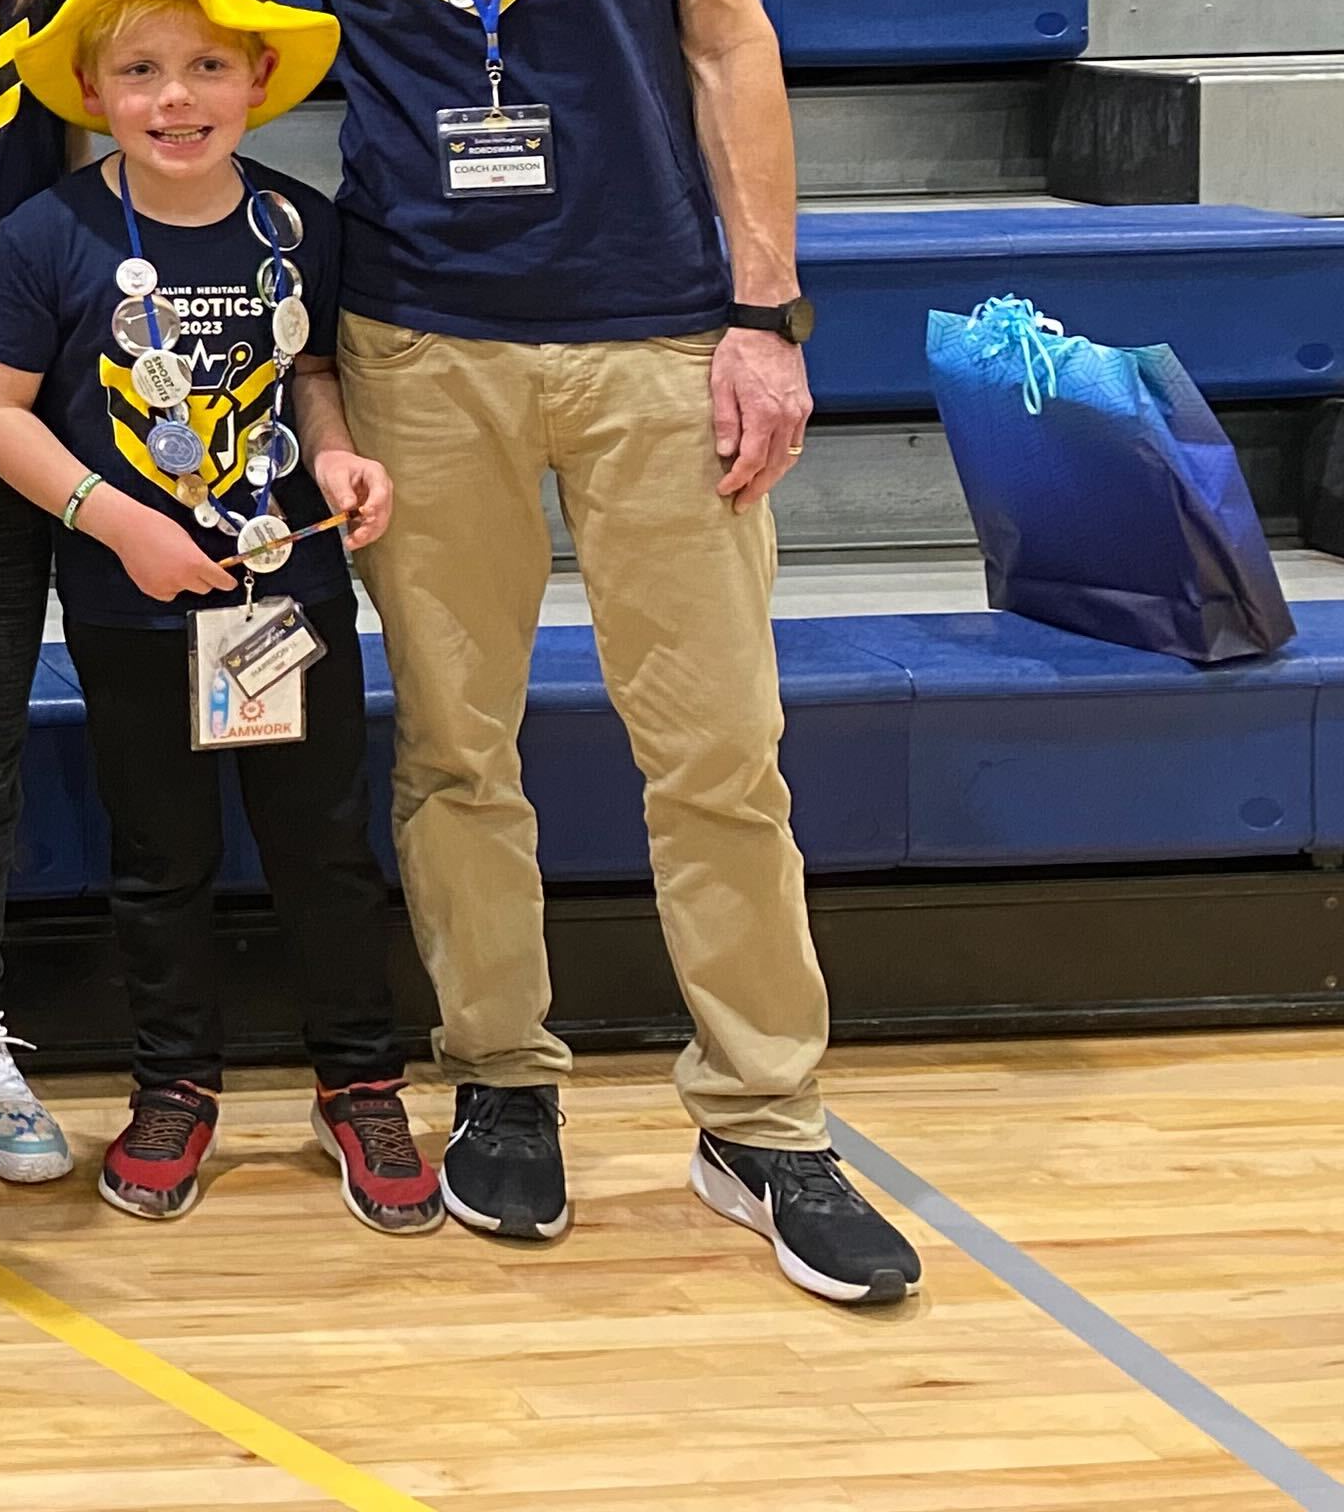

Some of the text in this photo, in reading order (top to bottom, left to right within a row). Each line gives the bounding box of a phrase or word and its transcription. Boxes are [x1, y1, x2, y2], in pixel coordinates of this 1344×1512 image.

[454, 162, 540, 174] COACH ATKINSON
[197, 286, 247, 295] HERITAGE
[174, 296, 264, 318] BOTICS
[180, 320, 223, 336] 2023
[152, 355, 174, 389] SHORT
[143, 359, 171, 403] CIRCUITS
[227, 722, 292, 737] AMWORK
